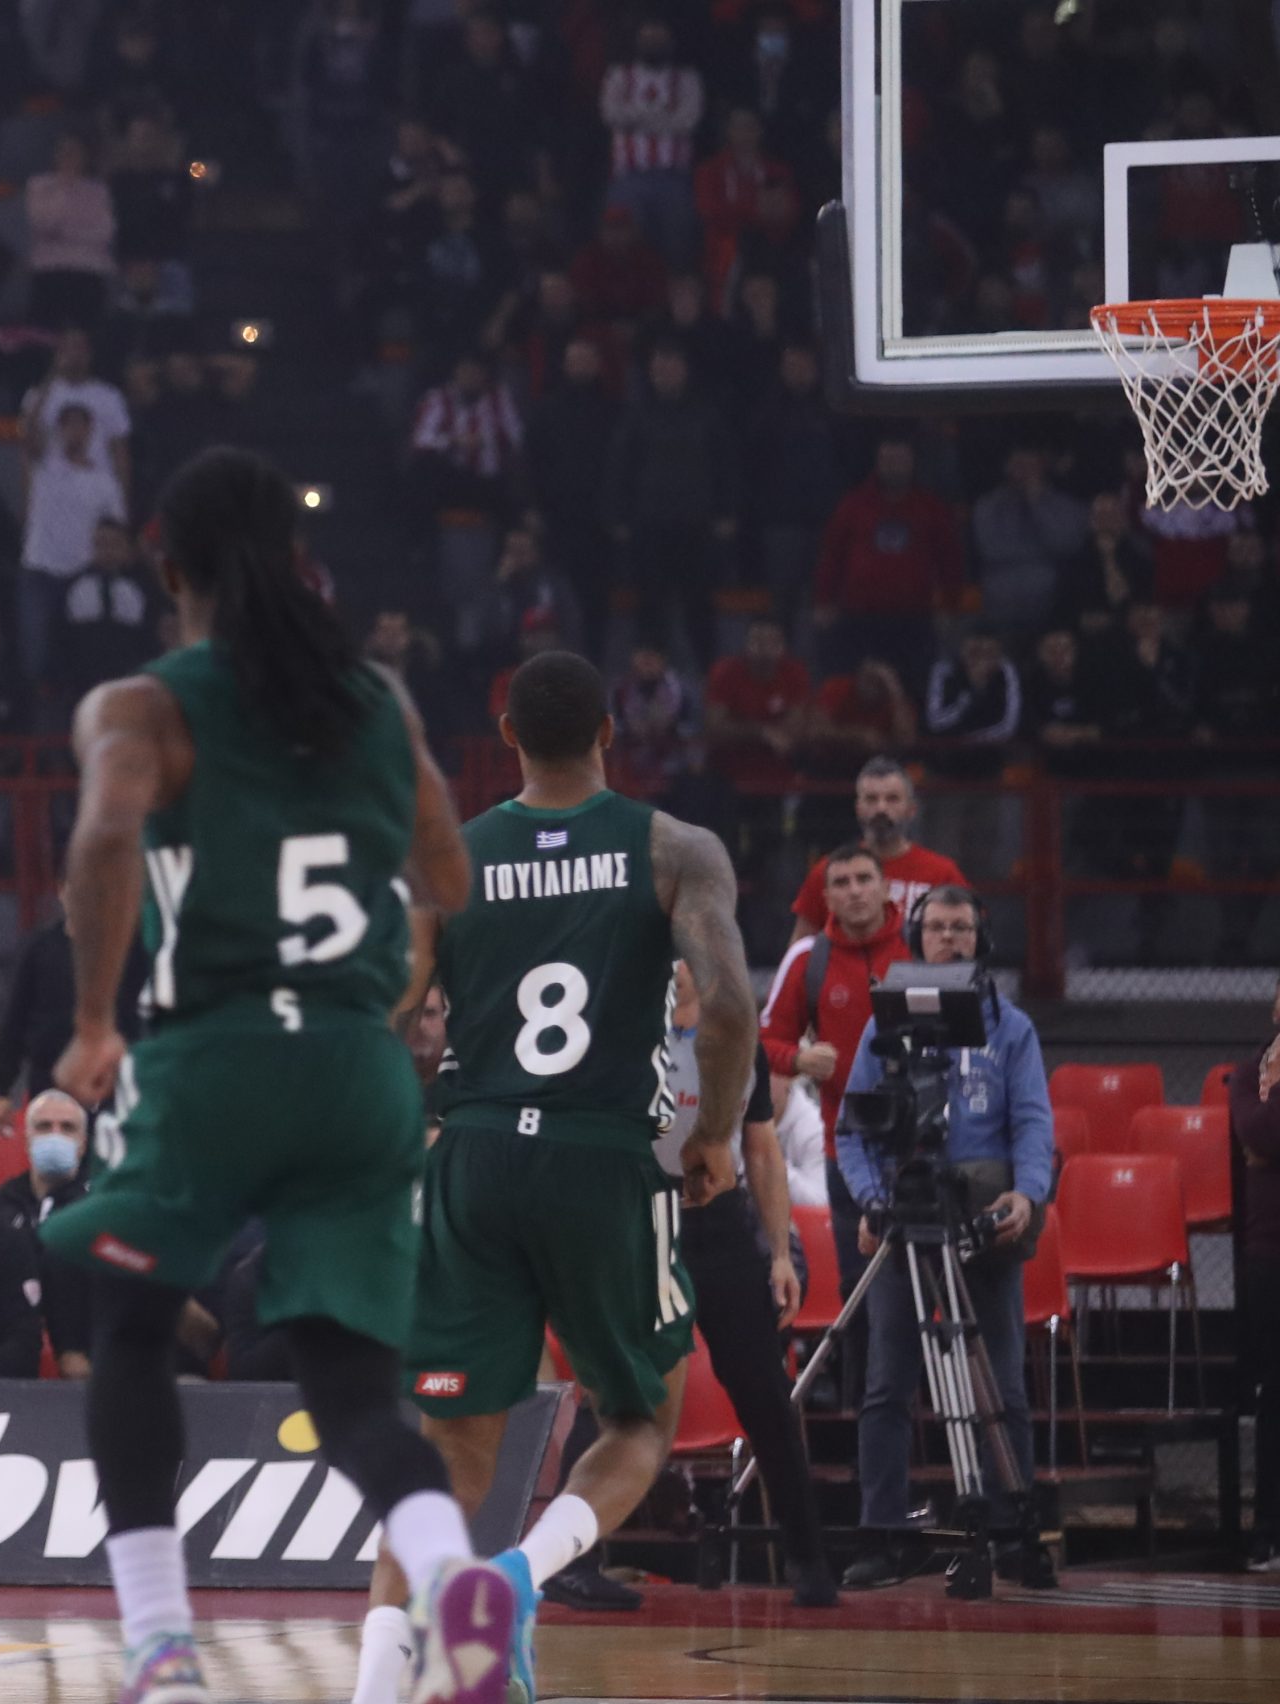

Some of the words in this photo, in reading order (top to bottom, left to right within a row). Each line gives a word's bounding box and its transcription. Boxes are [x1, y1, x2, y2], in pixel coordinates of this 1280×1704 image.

[278, 833, 369, 966] 5
[483, 852, 629, 902] ΓΟΥΙΛΙΑΜΣ
[514, 962, 591, 1076] 8
[517, 1107, 540, 1135] 8
[421, 1378, 460, 1392] AVIS
